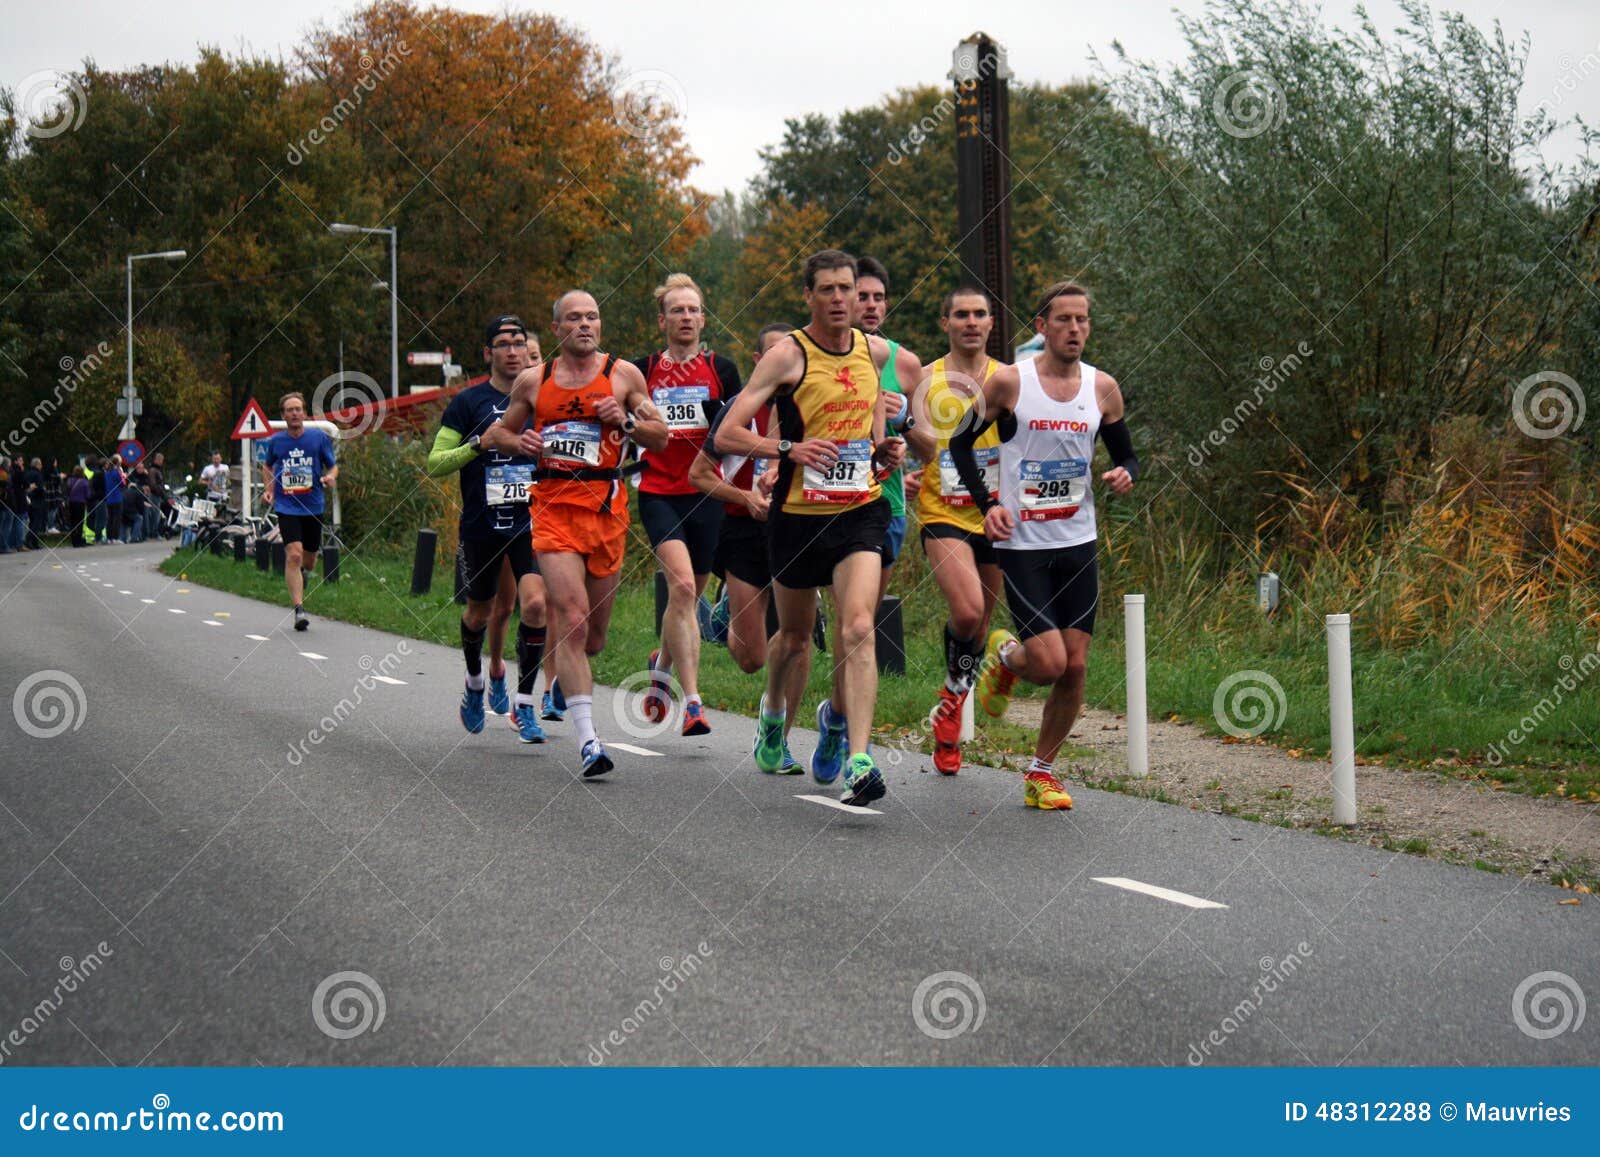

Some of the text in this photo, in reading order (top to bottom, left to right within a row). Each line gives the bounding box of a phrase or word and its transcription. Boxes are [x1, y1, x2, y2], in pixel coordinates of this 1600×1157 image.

[667, 404, 696, 420] 336
[824, 400, 869, 413] WELLINGTON
[282, 457, 312, 467] KLM
[503, 484, 526, 498] 276
[1037, 481, 1070, 498] 293
